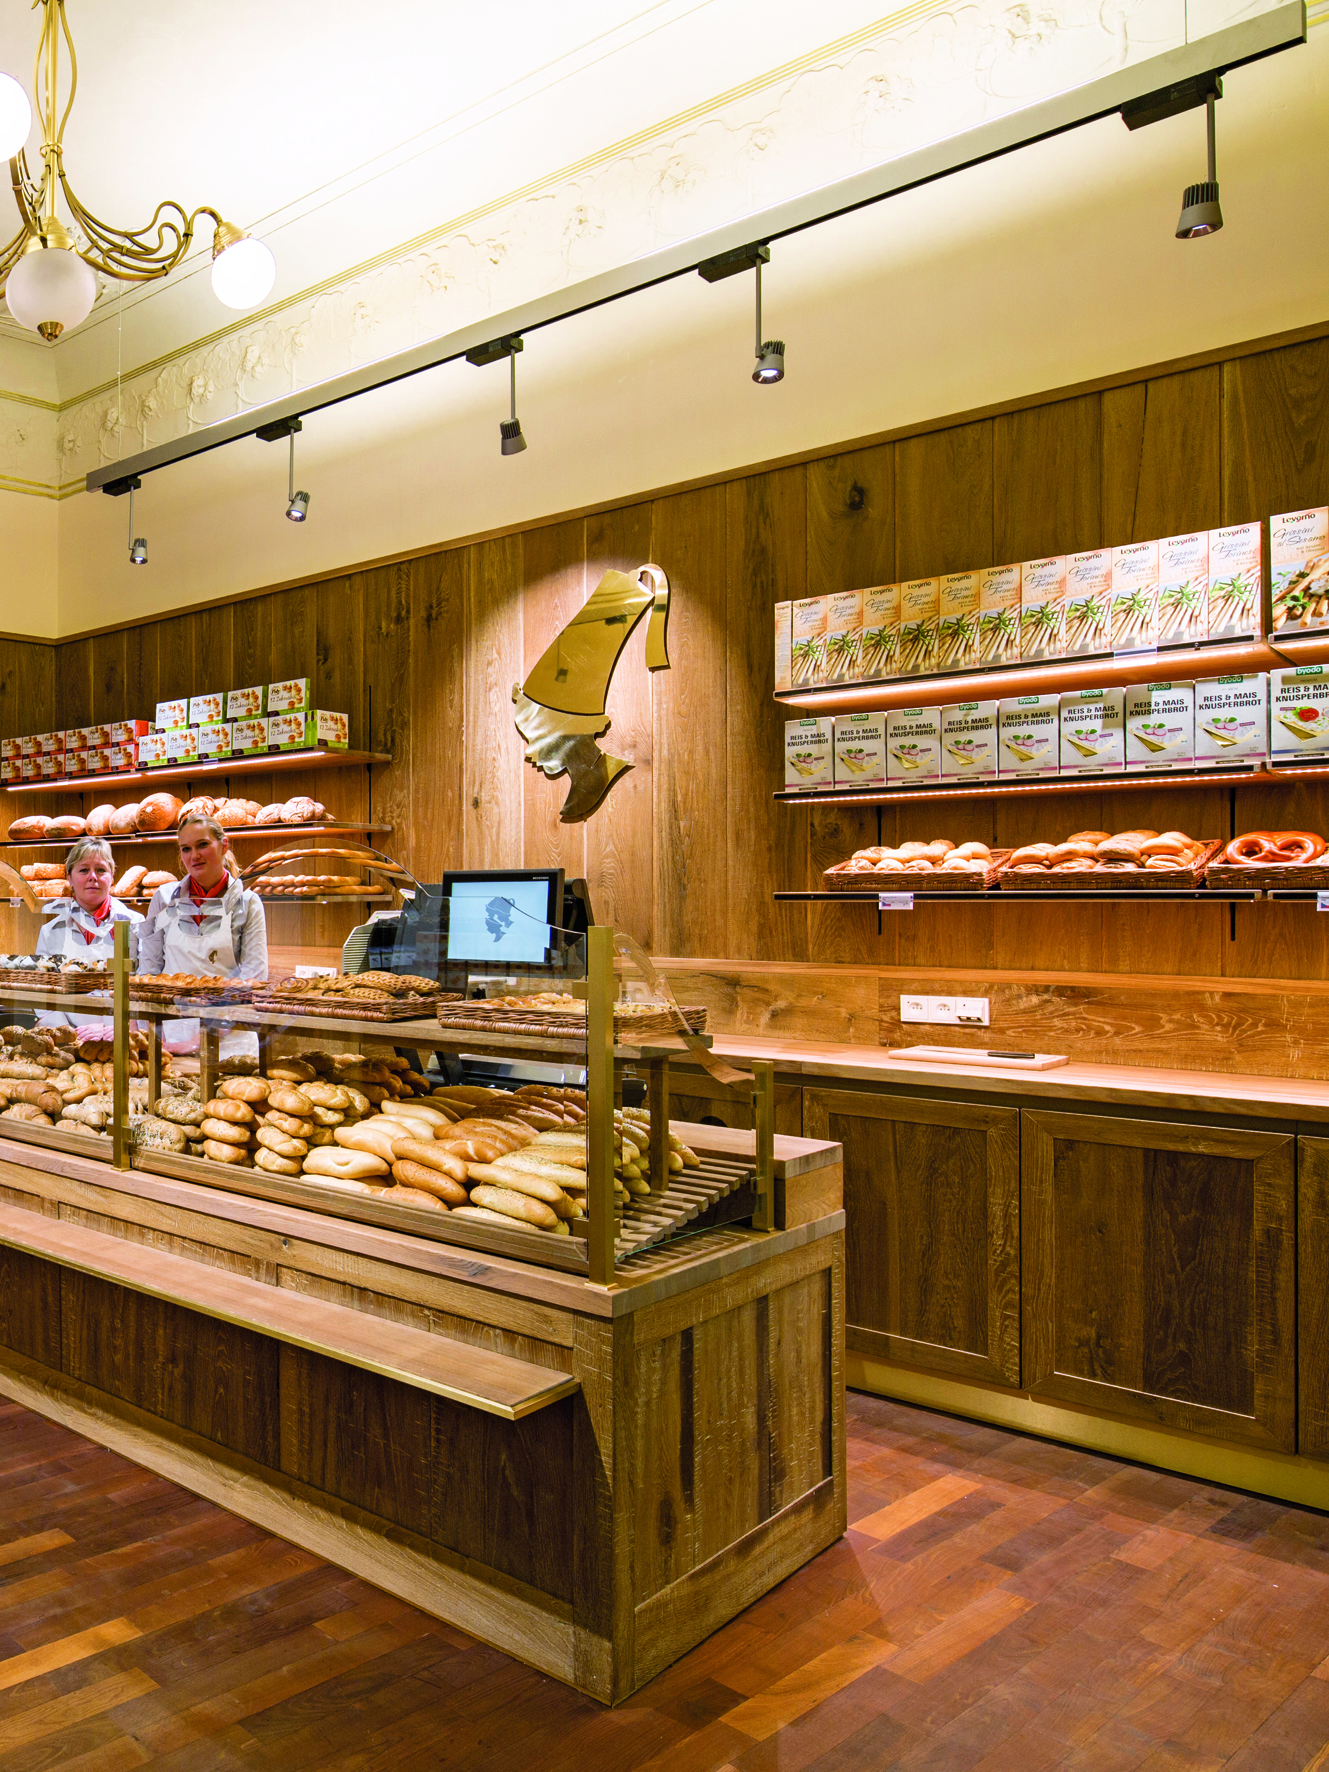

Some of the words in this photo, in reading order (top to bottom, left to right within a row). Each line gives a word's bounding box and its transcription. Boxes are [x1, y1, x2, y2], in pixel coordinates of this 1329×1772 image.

[1297, 666, 1322, 675] byodo
[1219, 675, 1242, 684] byodo
[1149, 683, 1170, 691] byodo
[1281, 686, 1301, 694] REIS
[1082, 690, 1102, 698] byodo
[1234, 692, 1258, 700] MAIS
[1094, 705, 1116, 713] MAIS
[1134, 701, 1152, 709] REIS
[1199, 699, 1262, 710] KNUSPERBROT
[1031, 711, 1051, 719] MAIS
[1130, 706, 1189, 716] KNUSPERBROT
[1064, 712, 1120, 722] KNUSPERBROT
[915, 722, 933, 730] MAIS
[1002, 718, 1054, 728] KNUSPERBROT
[944, 724, 993, 734] KNUSPERBROT
[837, 734, 882, 743] KNUSPERBROT
[890, 729, 937, 739] KNUSPERBROT
[787, 738, 829, 747] KNUSPERBROT
